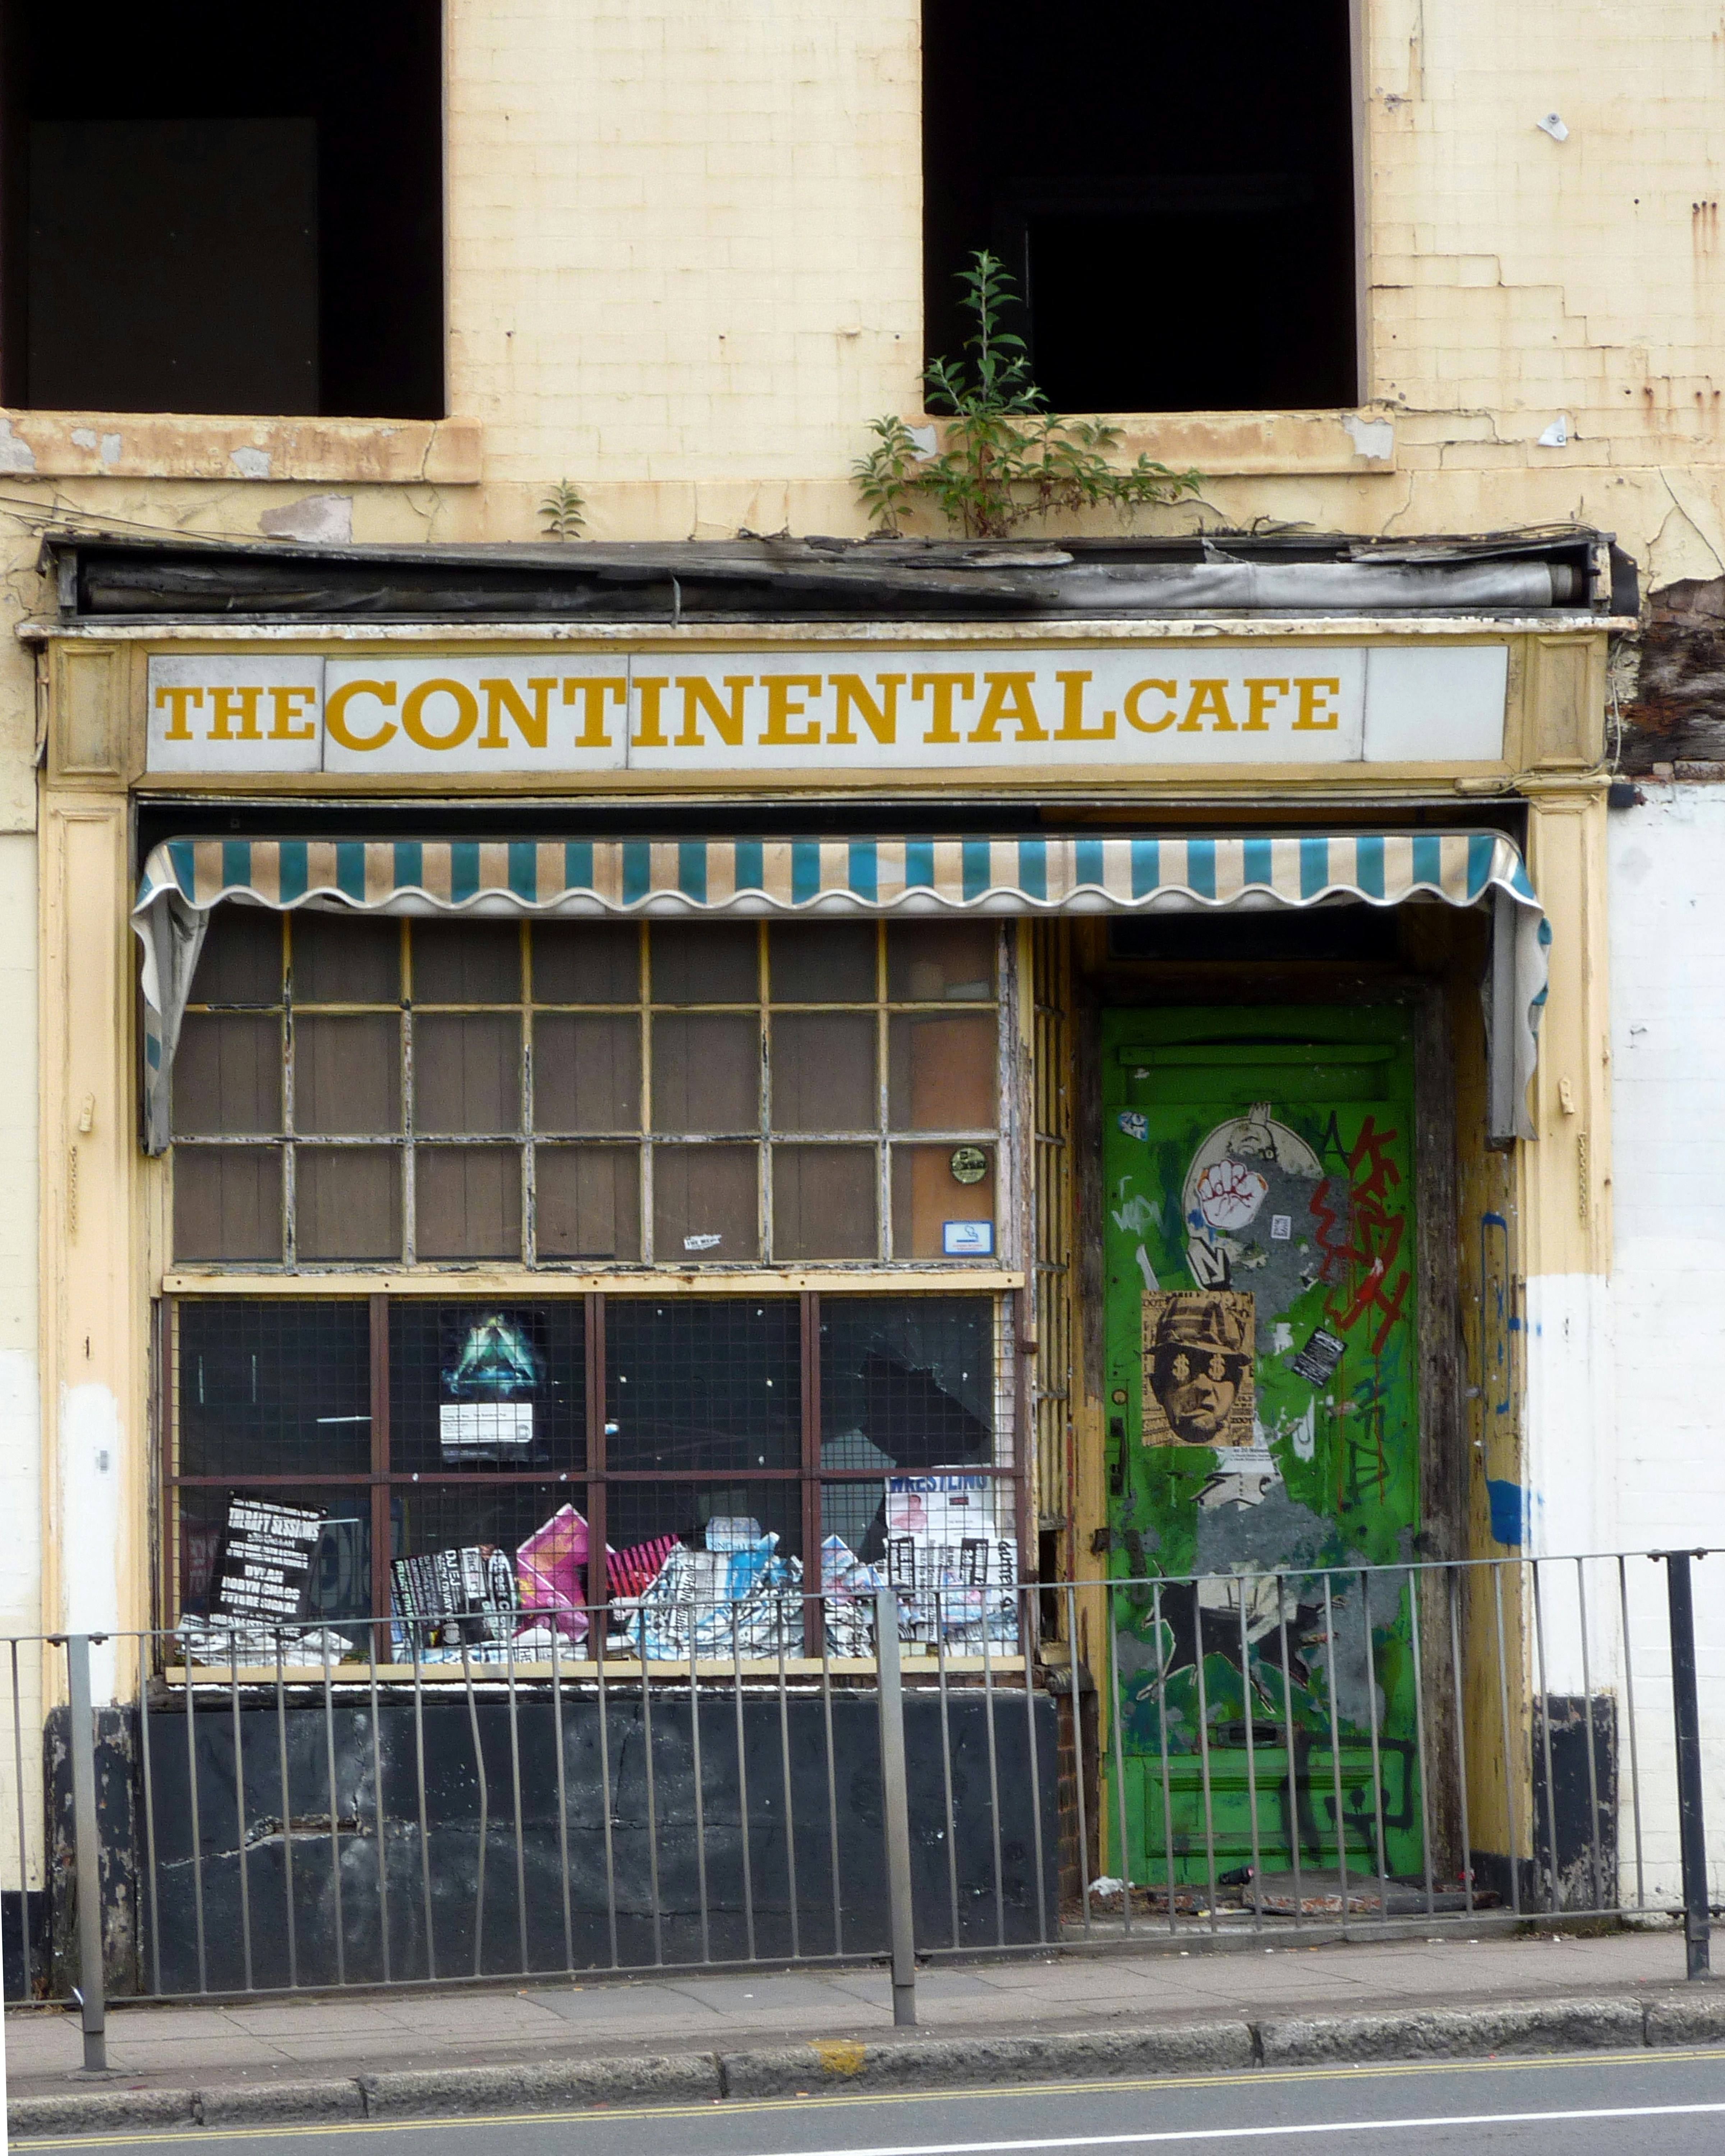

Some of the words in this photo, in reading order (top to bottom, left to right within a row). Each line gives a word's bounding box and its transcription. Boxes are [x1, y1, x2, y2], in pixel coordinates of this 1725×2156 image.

[156, 687, 315, 740] THE
[325, 671, 1116, 751] CONTINENTAL
[1124, 678, 1339, 732] CAFE
[445, 1549, 458, 1568] DJ
